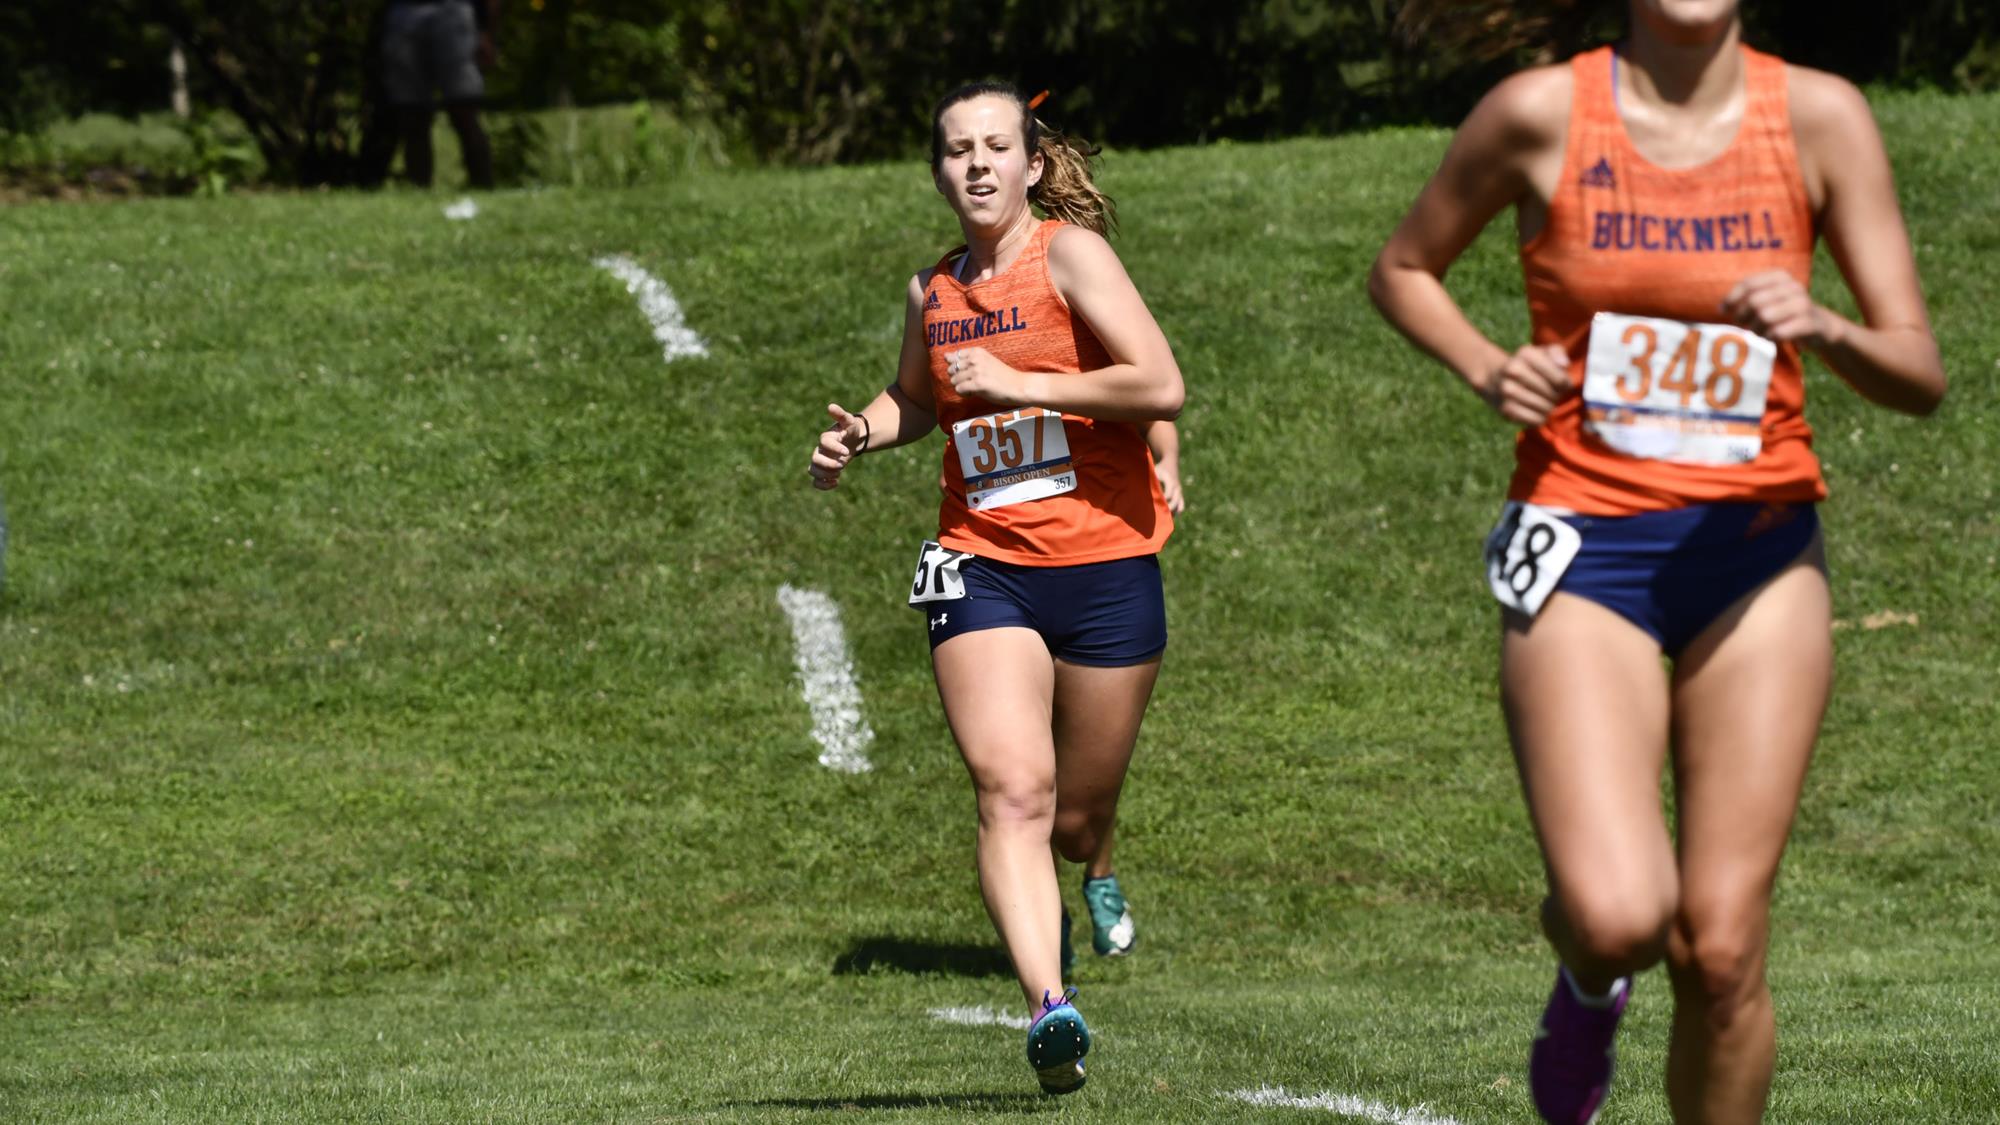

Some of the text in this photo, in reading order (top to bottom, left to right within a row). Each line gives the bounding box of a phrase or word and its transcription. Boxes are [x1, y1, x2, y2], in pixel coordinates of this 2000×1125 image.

[1592, 210, 1783, 251] BUCKNELL
[928, 306, 1026, 348] BUCKNELL
[1615, 324, 1749, 411] 348
[968, 407, 1045, 474] 357
[993, 474, 1022, 487] BISON
[1023, 468, 1051, 481] OPEN
[1053, 476, 1071, 489] 357
